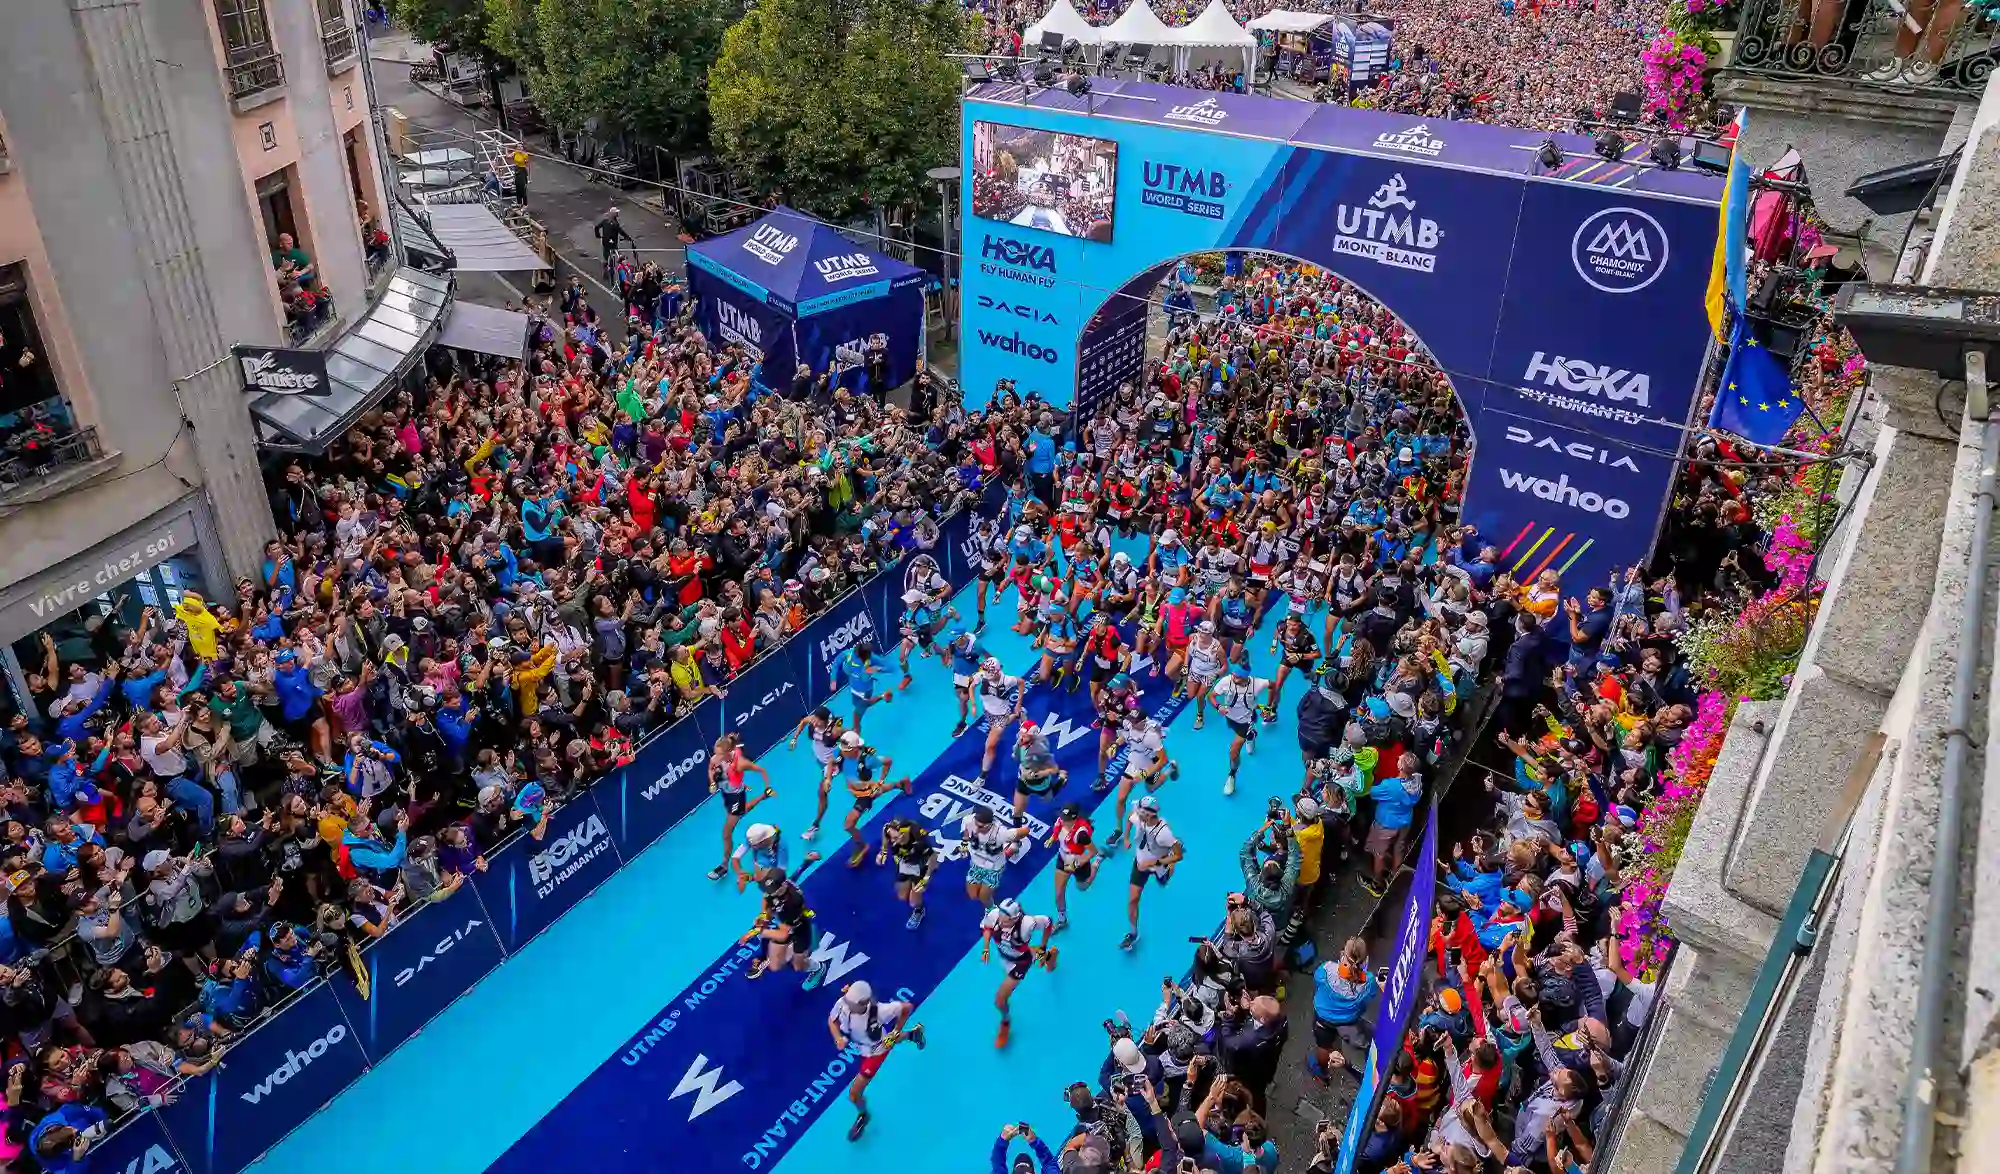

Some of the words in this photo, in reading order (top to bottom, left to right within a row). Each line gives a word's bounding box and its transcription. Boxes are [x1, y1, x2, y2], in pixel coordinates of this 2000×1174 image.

[1378, 132, 1444, 149] UTMB
[1143, 160, 1227, 198] UTMB
[1145, 190, 1184, 207] WORLD
[1187, 197, 1222, 217] SERIES
[753, 223, 797, 253] UTMB
[981, 233, 1057, 274] HOKA
[1337, 239, 1433, 268] MONT-BLANC
[813, 252, 871, 274] UTMB
[827, 269, 853, 281] WORLD
[854, 267, 876, 276] SERIES
[980, 263, 997, 275] FLY
[998, 267, 1037, 286] HUMAN
[1038, 276, 1056, 289] FLY
[1589, 255, 1645, 272] CHAMONIX
[1595, 266, 1636, 279] MONT-BLANC
[976, 295, 1060, 326] DACIA
[977, 328, 1059, 365] wahoo
[1523, 351, 1651, 407] HOKA
[1505, 425, 1641, 473] DACIA
[1499, 467, 1630, 520] wahoo
[28, 580, 91, 618] Vivre
[95, 552, 143, 587] chez
[146, 529, 176, 558] soi
[819, 610, 873, 662] HOKA
[735, 681, 794, 727] DACIA
[641, 749, 707, 801] wahoo
[528, 813, 607, 886] HOKA
[537, 879, 554, 900] FLY
[554, 849, 595, 885] HUMAN
[593, 836, 610, 856] FLY
[393, 919, 484, 988] DACIA
[240, 1023, 347, 1105] wahoo
